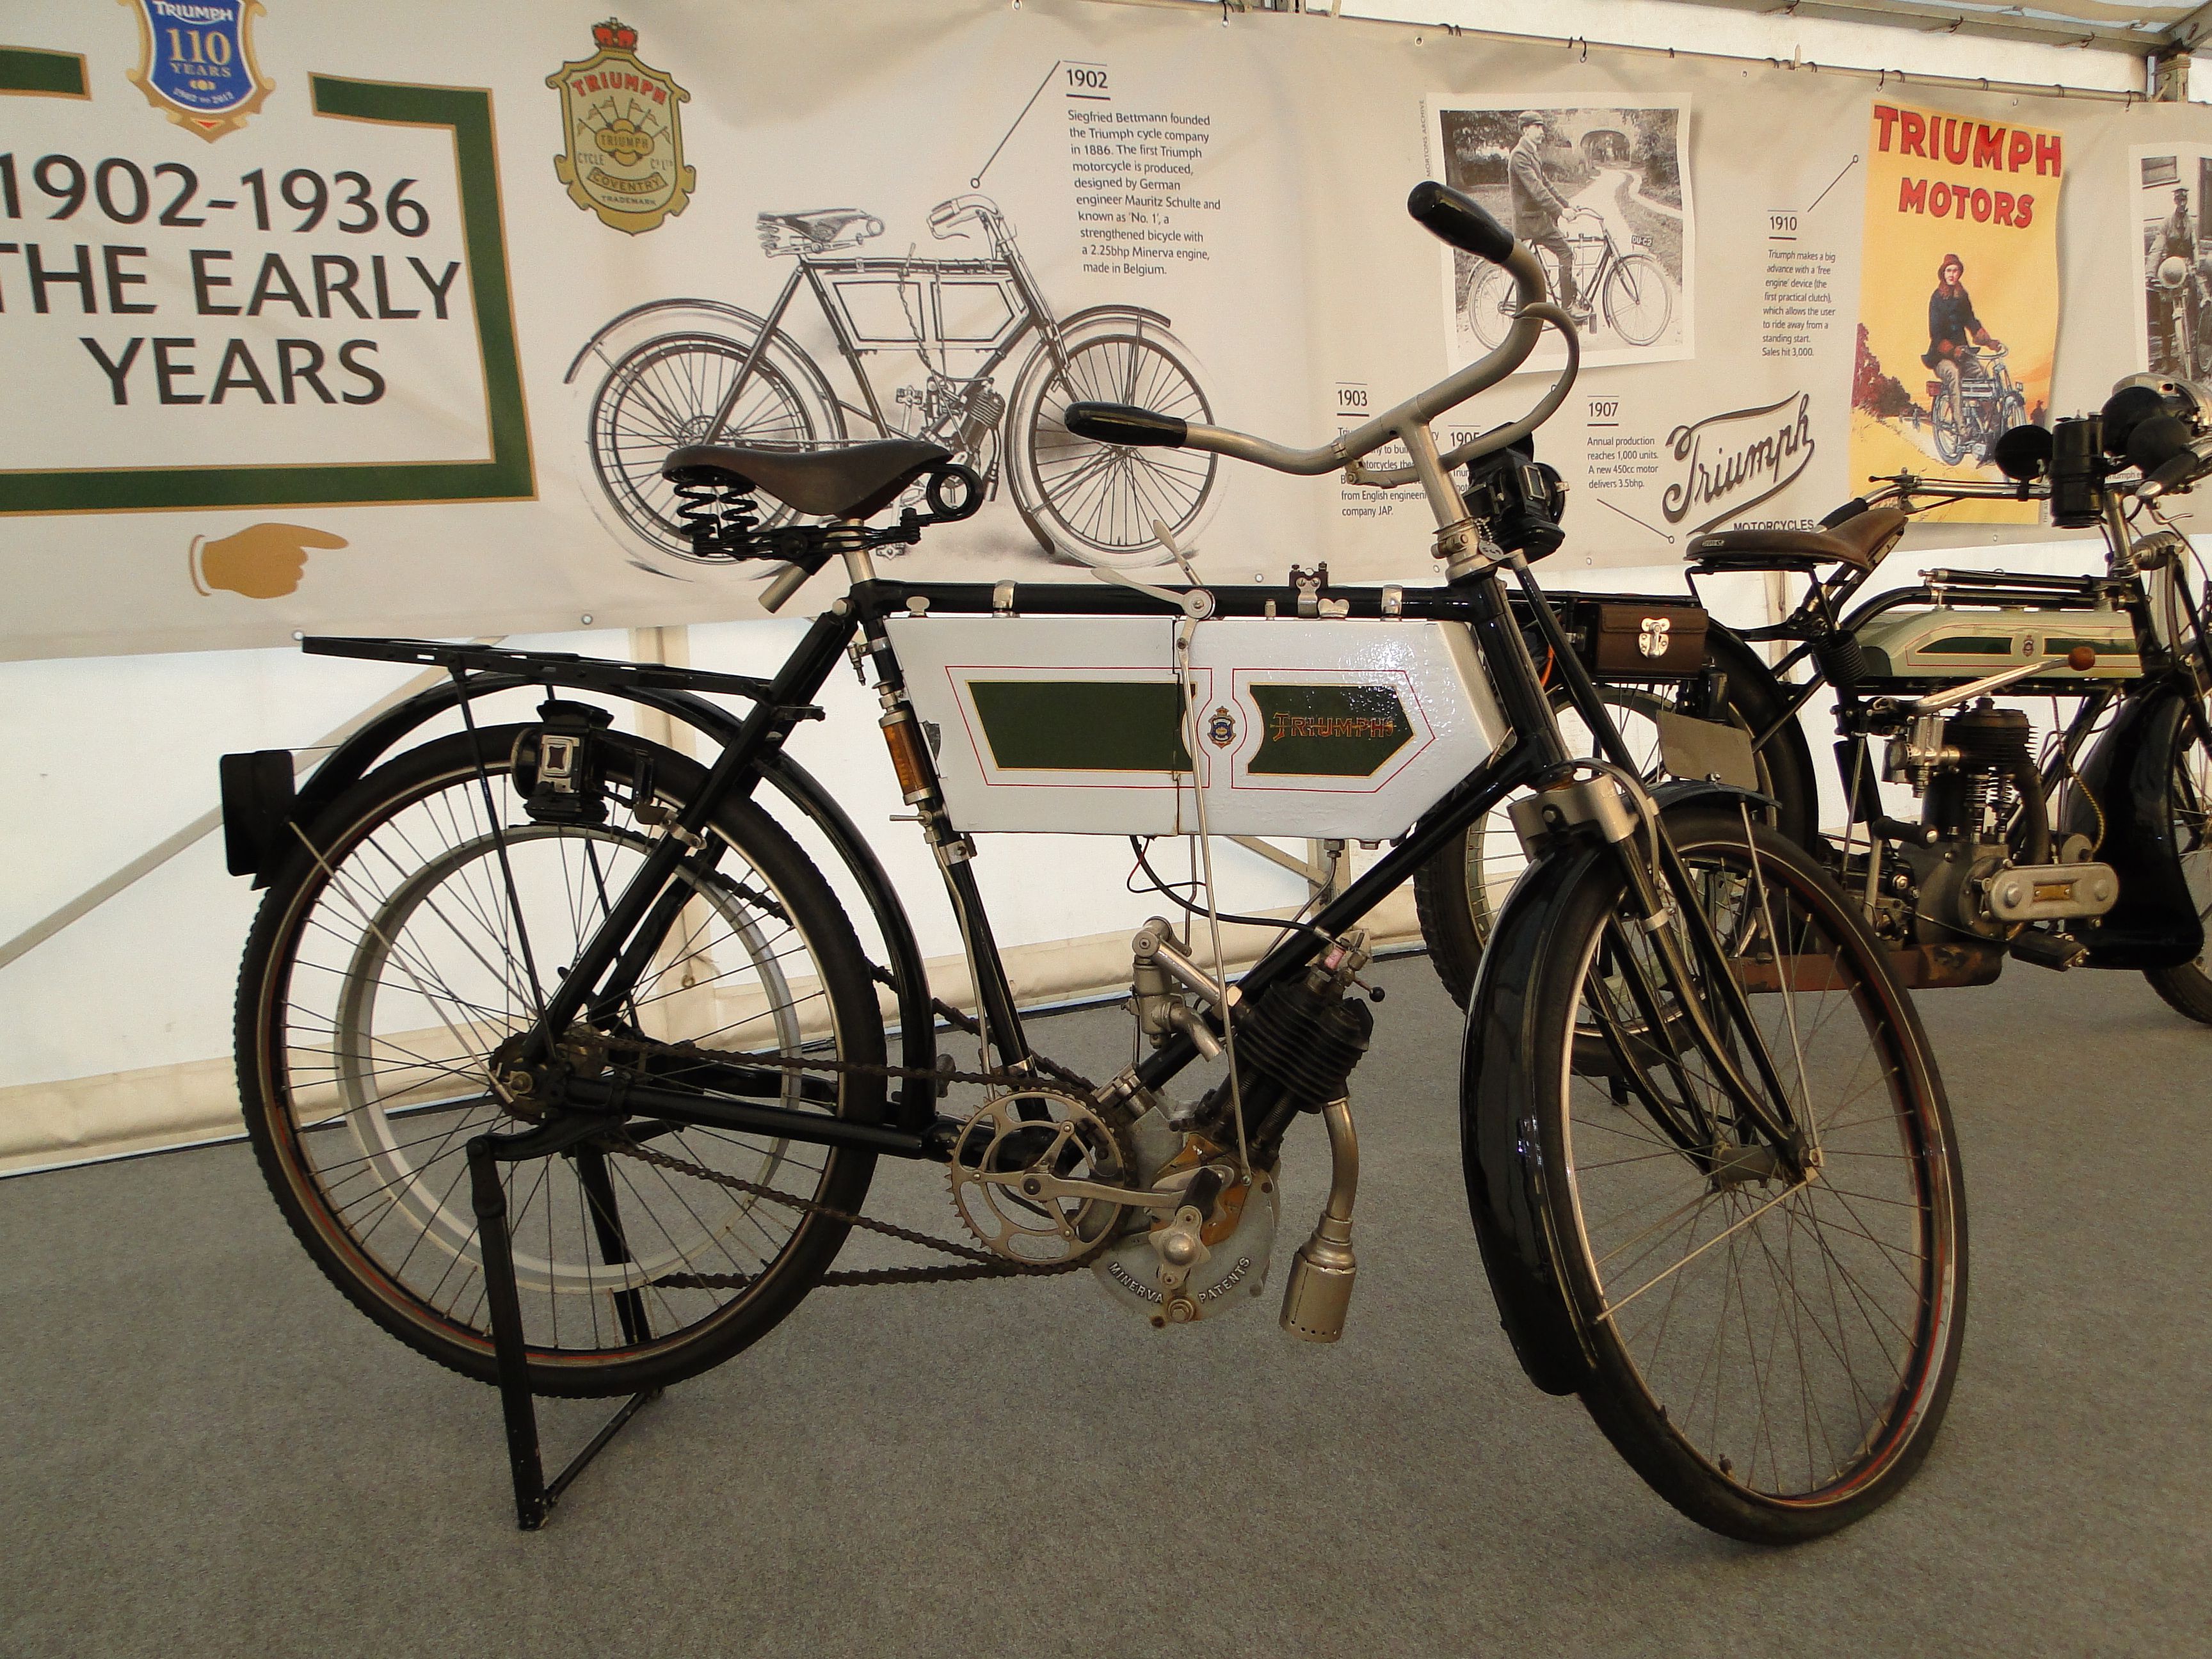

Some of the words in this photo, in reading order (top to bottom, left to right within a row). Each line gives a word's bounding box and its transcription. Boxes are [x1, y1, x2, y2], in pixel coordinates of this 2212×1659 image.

[152, 1, 234, 23] TRIUMPH
[166, 28, 231, 65] 110
[170, 63, 232, 77] YEARS
[1066, 69, 1108, 88] 1902
[570, 71, 668, 106] TRIUMPH
[1068, 110, 1112, 124] Siegfried
[1116, 112, 1167, 123] Bettmann
[1171, 113, 1210, 126] founded
[601, 135, 648, 148] TRIUMPH
[1070, 128, 1086, 138] the
[1089, 128, 1134, 140] Triumph
[1137, 129, 1162, 140] cycle
[1164, 132, 1209, 143] company
[1873, 105, 2063, 178] TRIUMPH
[1071, 145, 1080, 155] in
[1085, 145, 1113, 155] 1886.
[1116, 145, 1137, 155] The
[1140, 145, 1158, 156] first
[1160, 146, 1202, 159] Triumph
[1073, 161, 1131, 173] motorcycle
[1135, 162, 1141, 172] is
[1144, 163, 1193, 175] produced,
[593, 173, 660, 191] COVENTRY
[1074, 178, 1122, 190] designed
[1126, 178, 1137, 191] by
[1140, 179, 1180, 190] German
[0, 152, 431, 237] 1902-1936
[1077, 195, 1121, 206] engineer
[1125, 195, 1162, 207] Mauritz
[1166, 196, 1201, 209] Schulte
[1203, 199, 1221, 210] and
[1898, 177, 2034, 229] MOTORS
[1078, 212, 1113, 221] known
[1116, 213, 1125, 222] as
[1164, 215, 1169, 223] a
[1770, 216, 1797, 230] 1910
[1080, 228, 1144, 241] strengthened
[1148, 230, 1181, 243] bicycle
[1184, 231, 1203, 242] with
[1091, 245, 1129, 257] 2.25bhp
[1132, 247, 1173, 258] Minerva
[1176, 248, 1210, 260] engine,
[1768, 250, 1795, 260] Triumph
[1825, 253, 1836, 263] big
[1083, 263, 1109, 273] made
[1112, 263, 1120, 273] in
[1123, 264, 1167, 275] Belgium.
[1795, 266, 1809, 274] with
[189, 249, 462, 321] EARLY
[1791, 279, 1813, 287] device
[1814, 280, 1827, 289] (the
[1778, 294, 1806, 303] practical
[1763, 307, 1783, 316] which
[1785, 307, 1806, 316] allows
[1772, 321, 1785, 329] ride
[1787, 322, 1804, 330] away
[1763, 334, 1791, 344] standing
[1762, 348, 1780, 356] Sales
[1782, 348, 1790, 356] hit
[1792, 348, 1813, 357] 3,000.
[79, 337, 387, 406] YEARS
[1337, 390, 1368, 406] 1903
[1588, 401, 1618, 417] 1907
[1587, 437, 1613, 446] Annual
[1615, 436, 1655, 447] production
[1587, 451, 1615, 461] reaches
[1617, 451, 1637, 461] 1,000
[1639, 451, 1658, 460] units.
[1662, 390, 1815, 536] Triumph
[1588, 465, 1594, 474] A
[1613, 465, 1635, 474] 450cc
[1637, 465, 1658, 474] motor
[1589, 479, 1616, 488] delivers
[1619, 479, 1645, 490] 3.5bhp.
[1342, 491, 1359, 500] from
[1362, 491, 1388, 502] English
[1390, 491, 1427, 502] engineeri
[1342, 508, 1376, 517] company
[1379, 506, 1393, 515] JAP.
[1734, 520, 1814, 531] MOTORCYCLES
[1271, 712, 1390, 742] TRIUMPH
[1108, 1262, 1164, 1304] MINERVA
[1198, 1256, 1251, 1304] PATENTS
